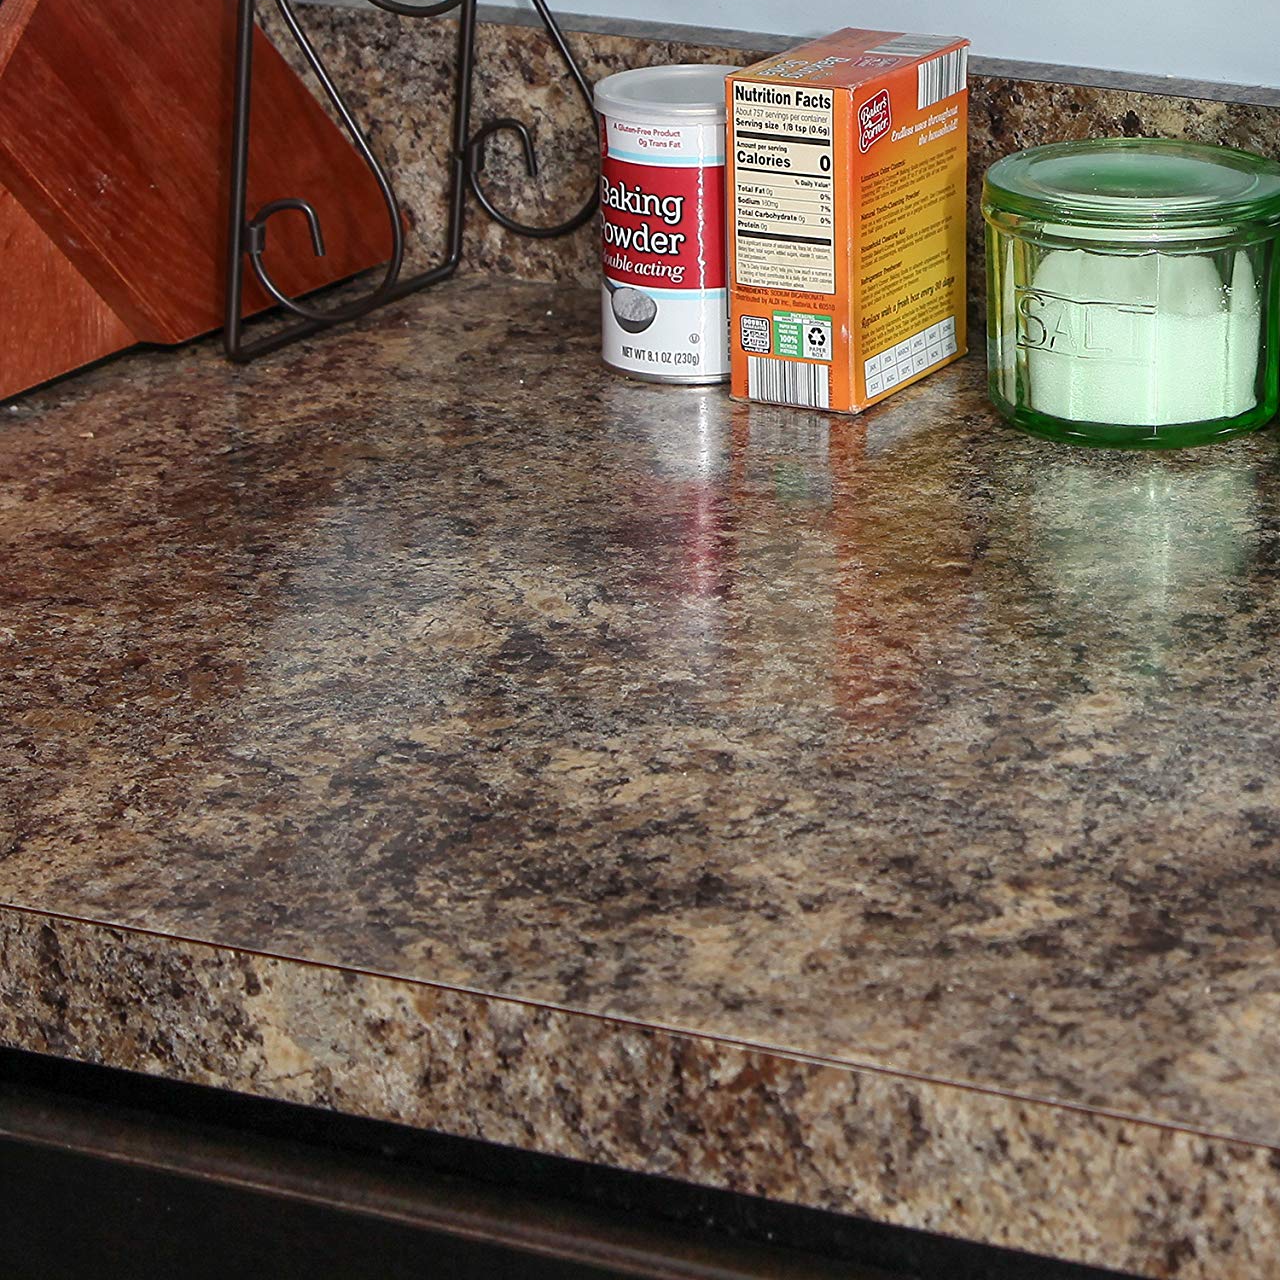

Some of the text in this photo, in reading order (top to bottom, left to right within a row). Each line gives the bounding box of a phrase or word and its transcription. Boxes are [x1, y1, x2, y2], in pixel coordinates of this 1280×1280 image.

[735, 85, 831, 109] Nutrition Facts
[736, 107, 828, 123] About 757 servings per container
[618, 123, 651, 136] Gluten-Free
[653, 128, 681, 138] Product
[736, 118, 830, 136] Serving size 1/8 tsp (0.6g)
[638, 138, 681, 149] 0g Trans Fat
[736, 141, 756, 149] Amount
[768, 145, 788, 153] serving
[737, 150, 831, 172] Calories 0
[738, 184, 753, 192] Total
[766, 188, 773, 196] 0g
[820, 193, 831, 201] 0%
[738, 196, 831, 213] Sodium 7%
[738, 208, 753, 216] Total
[755, 210, 797, 221] Carbohydrate
[738, 220, 768, 231] Protein 0g
[634, 260, 685, 283] acting
[780, 335, 798, 344] 100%
[622, 346, 700, 366] NET WT 8.1 OZ (230g)
[809, 346, 826, 354] PAPER
